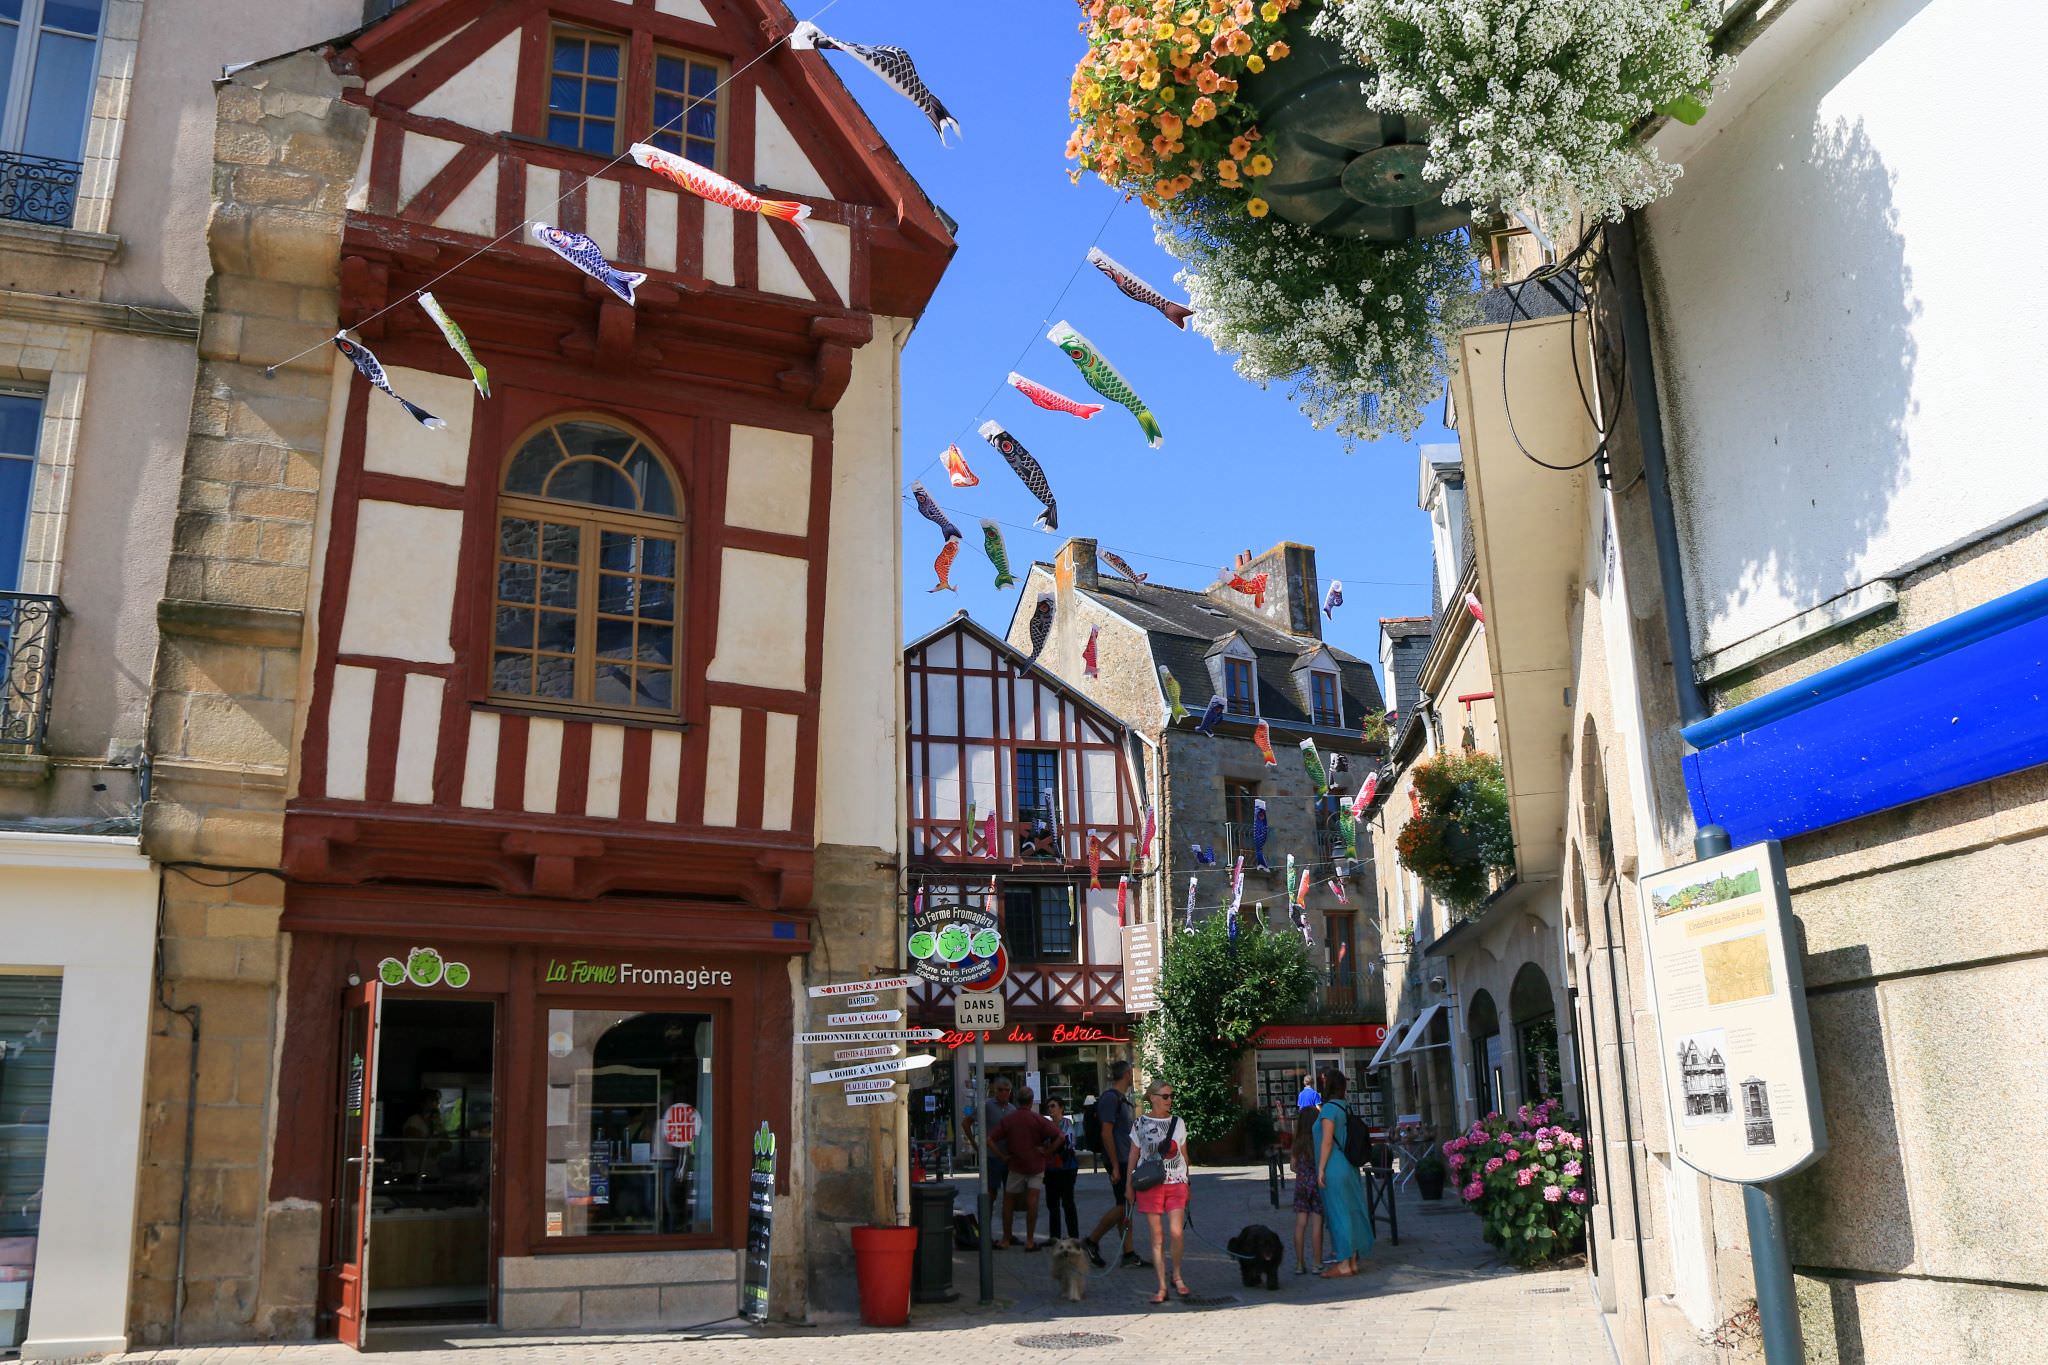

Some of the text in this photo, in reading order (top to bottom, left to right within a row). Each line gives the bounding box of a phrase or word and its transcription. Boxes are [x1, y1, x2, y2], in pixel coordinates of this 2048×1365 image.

[914, 907, 993, 928] La Ferme Fromagère
[917, 959, 938, 974] Beurre
[961, 959, 990, 975] Fromage
[545, 959, 732, 990] La Ferme Fromagère
[952, 966, 992, 983] Conserves
[820, 983, 864, 994] SOULIERS
[874, 979, 908, 990] JUPONS
[964, 999, 995, 1010] DANS
[832, 1015, 858, 1023] CACAO
[866, 1013, 888, 1021] GOGO
[960, 1013, 1000, 1024] LA RUE
[801, 1032, 861, 1041] CORDONNIER
[862, 1031, 871, 1040] &
[1303, 1035, 1312, 1045] du
[834, 1068, 859, 1078] BOIRE
[874, 1061, 907, 1072] MANGER
[855, 1094, 885, 1103] BIJOUX
